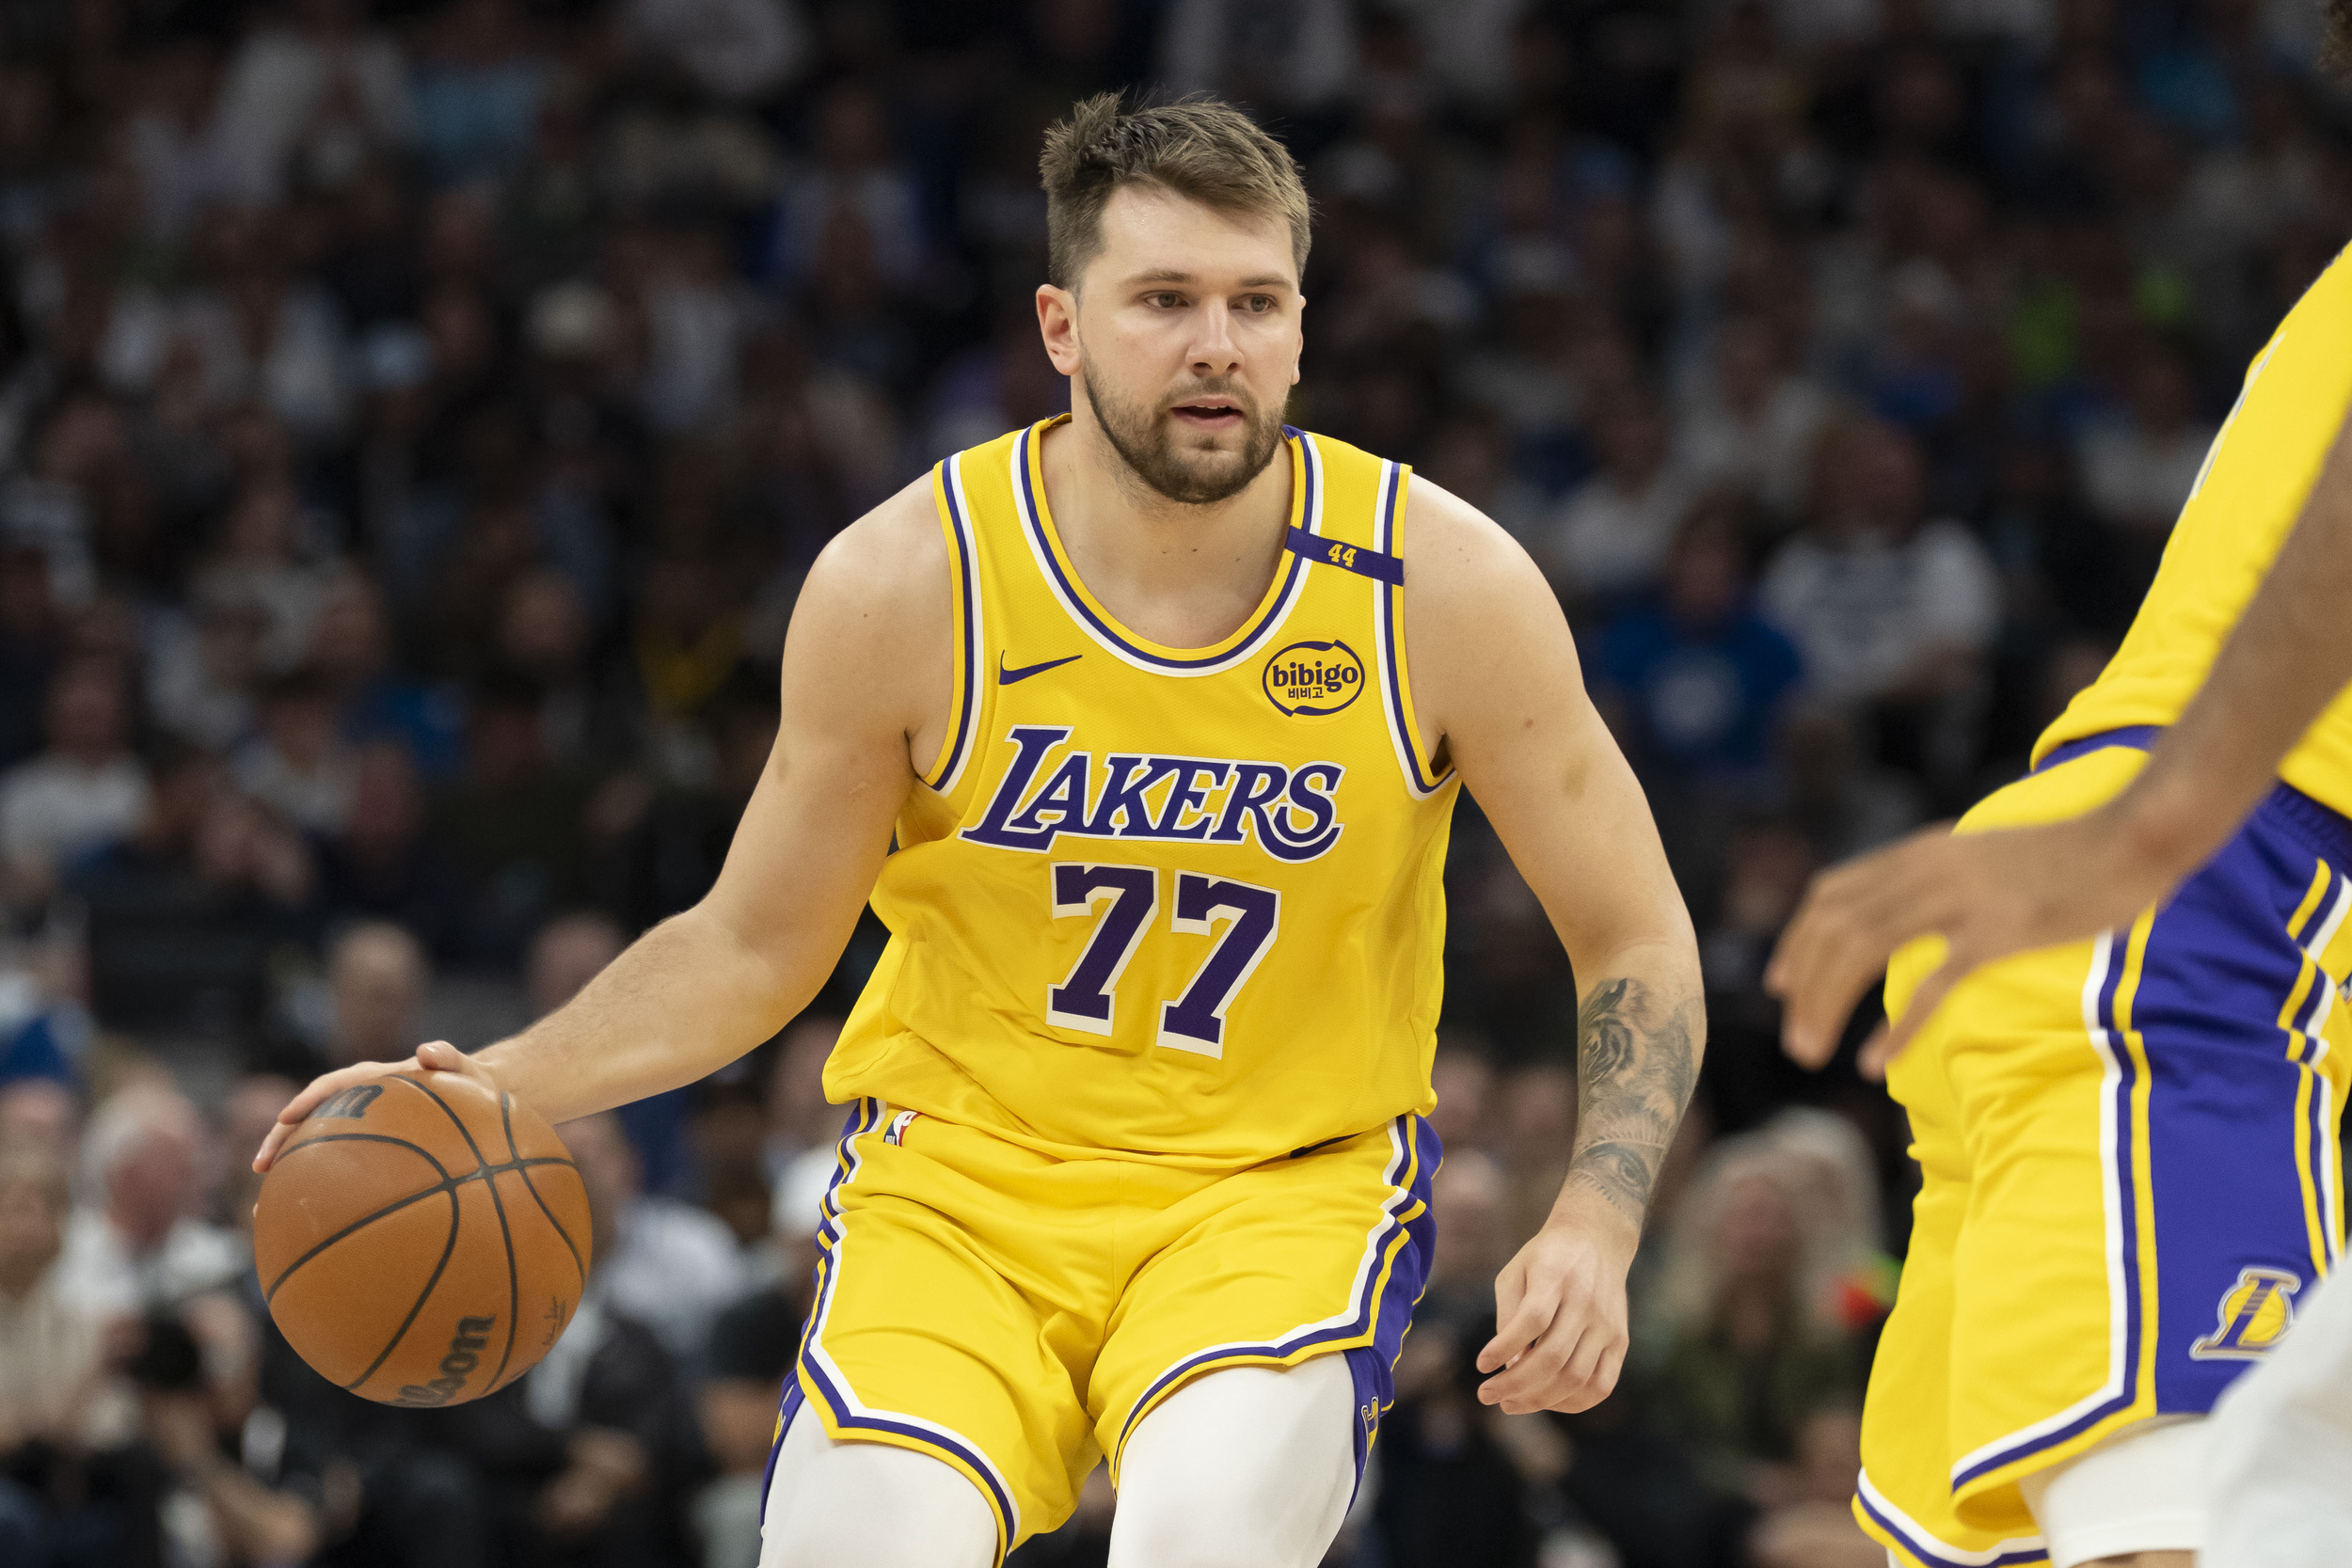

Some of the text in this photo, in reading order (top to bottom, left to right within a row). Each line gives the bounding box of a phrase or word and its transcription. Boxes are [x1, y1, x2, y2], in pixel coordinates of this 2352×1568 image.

[1327, 544, 1357, 567] 44
[1272, 660, 1358, 692] bibigo
[1288, 687, 1324, 700] 비비고
[958, 724, 1345, 863] LAKERS
[1045, 862, 1281, 1060] 77
